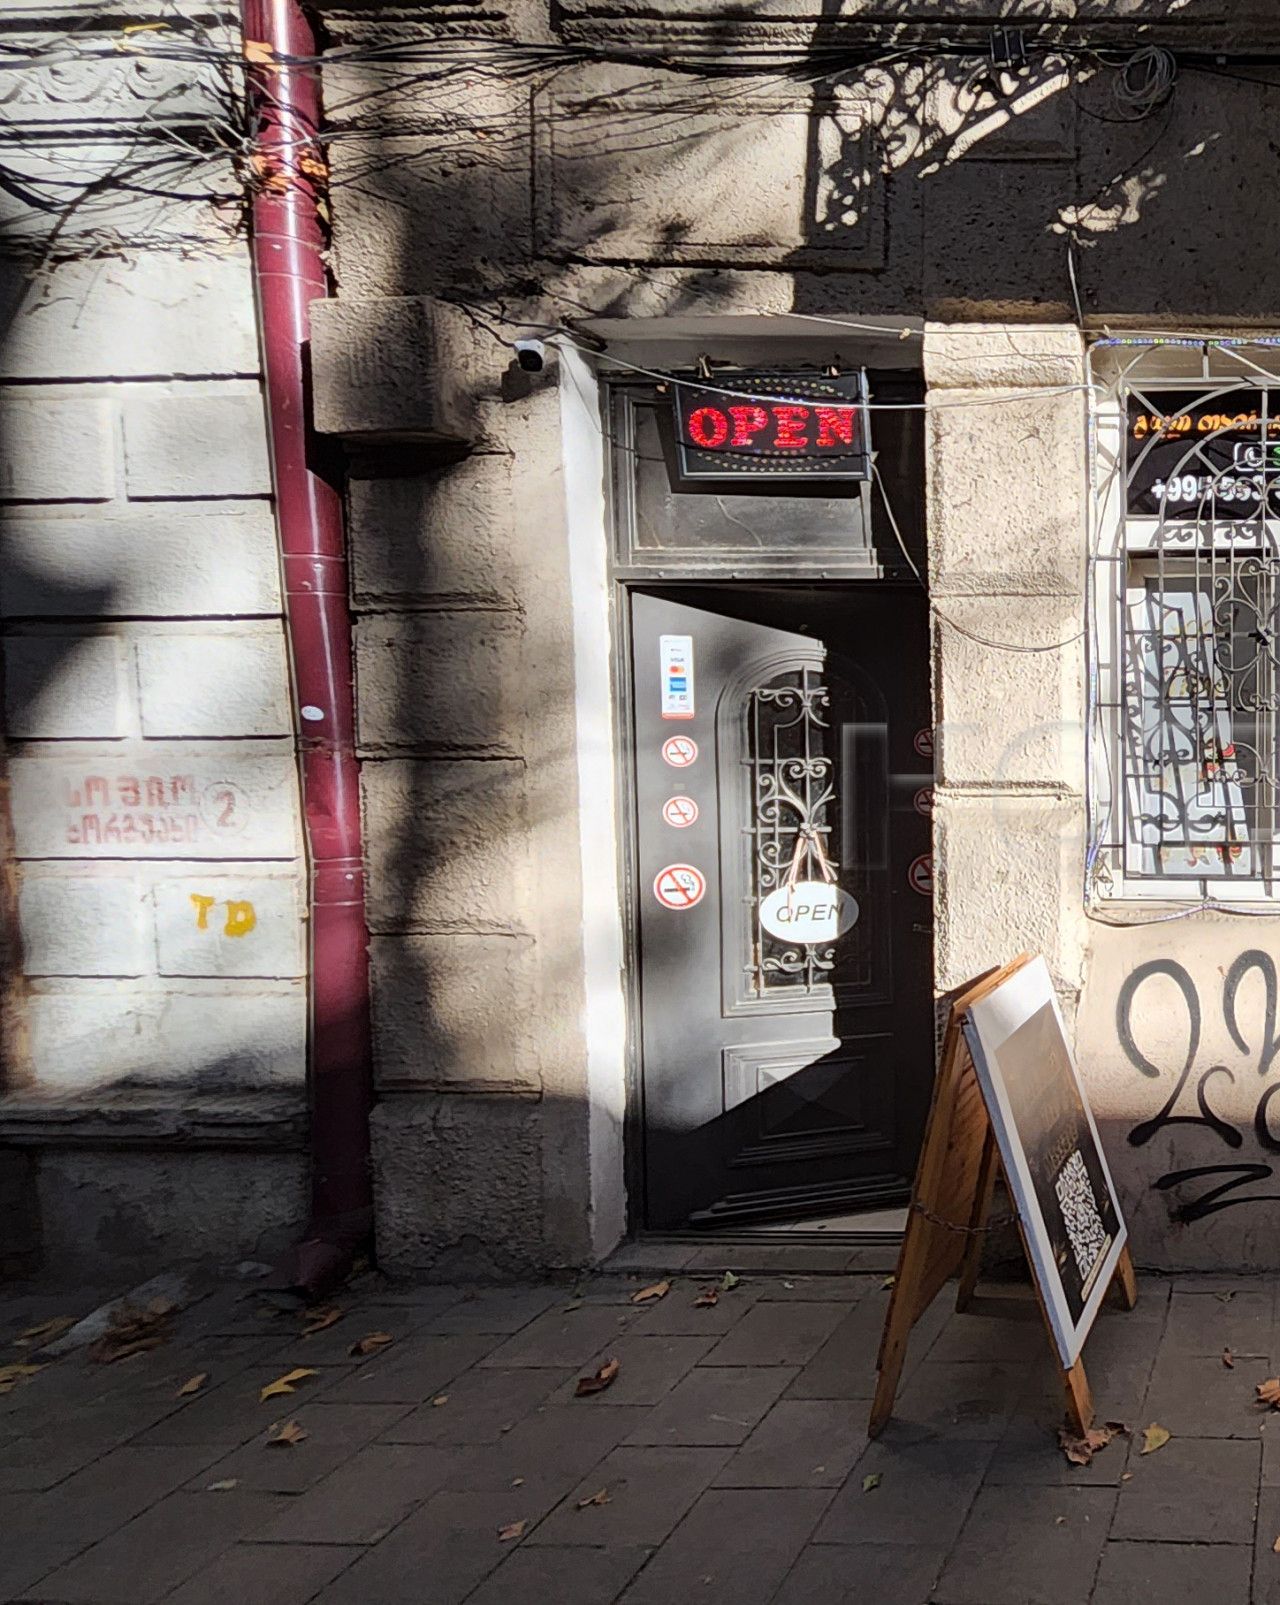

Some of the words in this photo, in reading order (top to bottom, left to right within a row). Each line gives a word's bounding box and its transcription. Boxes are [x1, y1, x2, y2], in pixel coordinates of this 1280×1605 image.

[688, 405, 856, 448] OPEN
[214, 789, 236, 828] 2
[776, 902, 845, 924] OPEN
